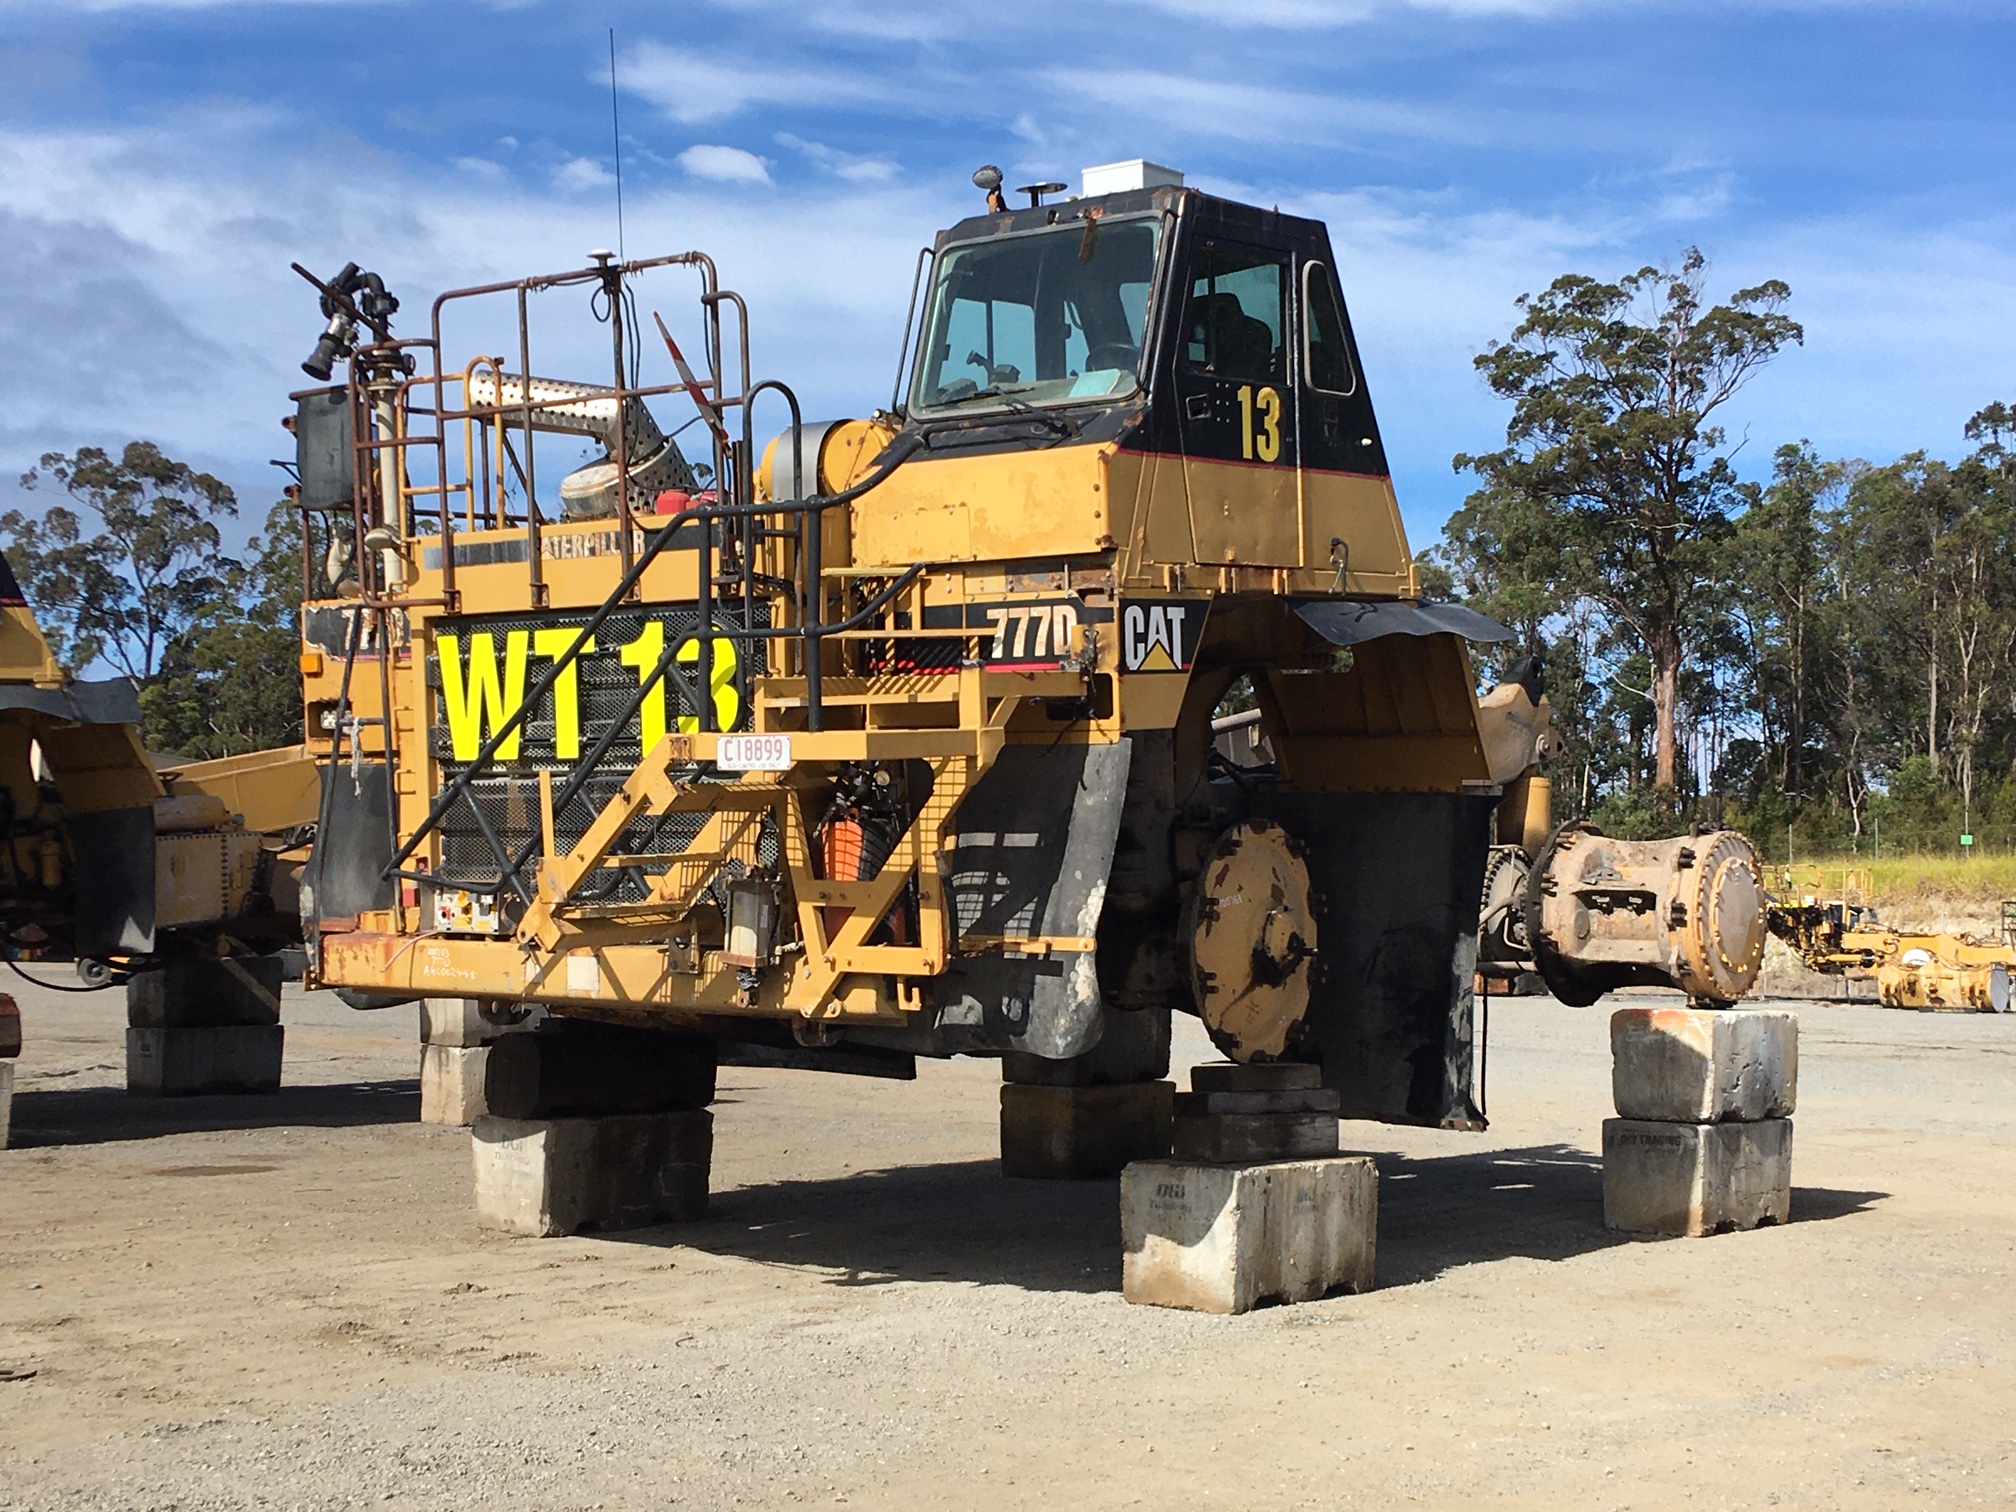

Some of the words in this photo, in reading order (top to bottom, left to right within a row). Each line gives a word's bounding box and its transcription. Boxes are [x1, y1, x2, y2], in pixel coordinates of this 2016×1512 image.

[1236, 384, 1281, 463] 13
[530, 530, 645, 560] ATERPILLR
[986, 604, 1078, 660] 777D
[1123, 605, 1186, 672] CAT
[436, 627, 596, 762] WT
[620, 621, 740, 760] 13
[724, 738, 783, 762] C18899
